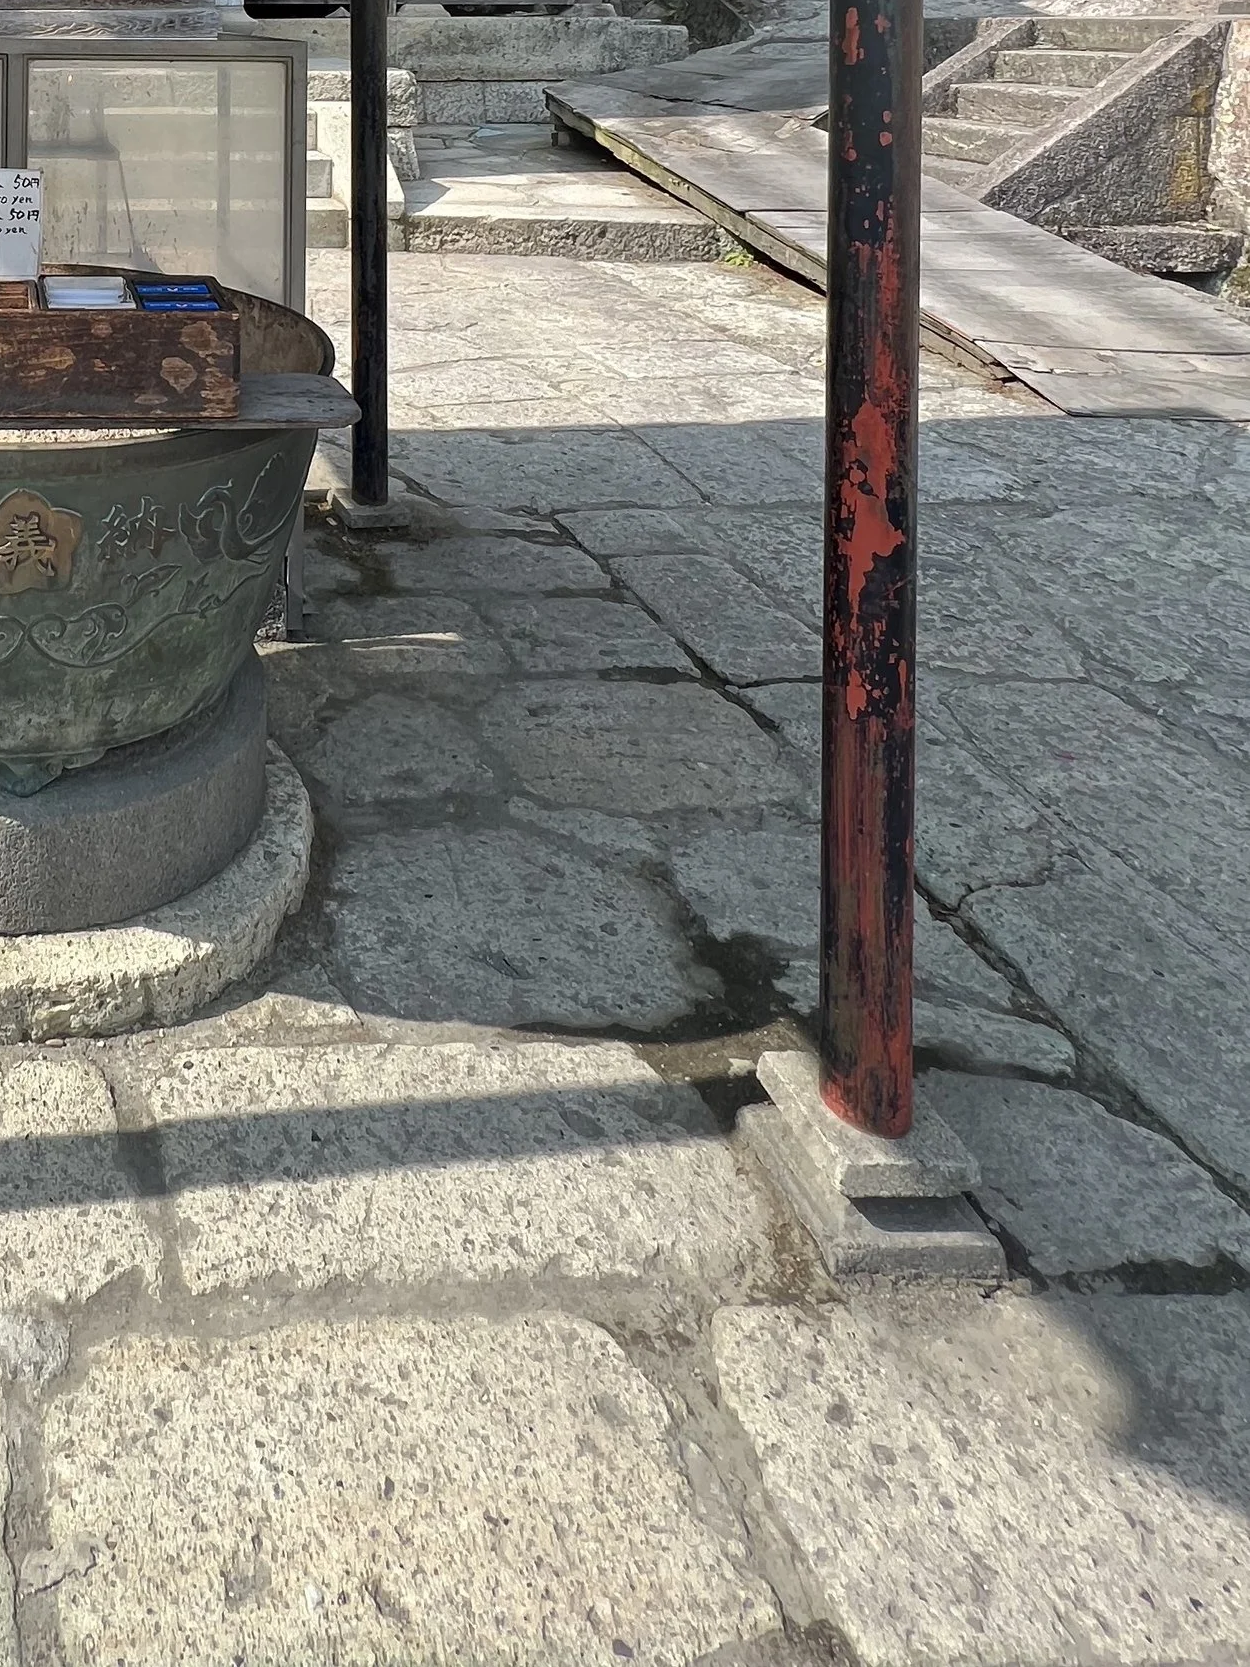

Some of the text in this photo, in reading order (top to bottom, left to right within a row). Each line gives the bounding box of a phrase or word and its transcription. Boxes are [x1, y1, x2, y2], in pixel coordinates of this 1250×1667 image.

[13, 174, 40, 190] 50円
[11, 196, 34, 205] yen
[8, 208, 40, 222] 50円
[4, 227, 28, 236] yen
[96, 495, 177, 559] 納
